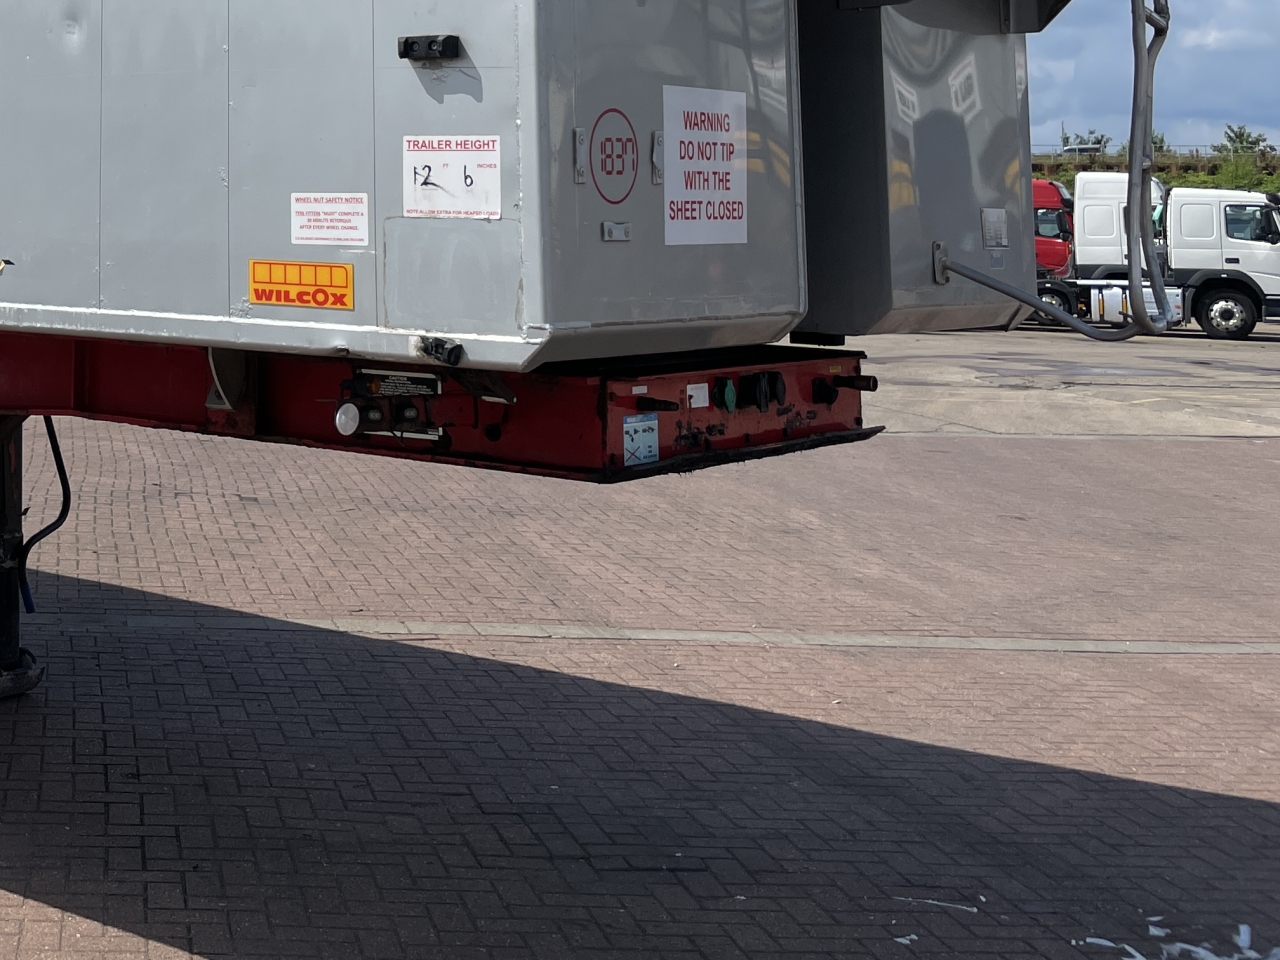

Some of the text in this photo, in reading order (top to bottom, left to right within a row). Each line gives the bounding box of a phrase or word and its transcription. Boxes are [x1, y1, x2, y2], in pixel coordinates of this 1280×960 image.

[683, 110, 730, 132] WARNING
[406, 140, 496, 149] TRAILER HEIGHT
[679, 140, 734, 161] DO NOT TIP
[464, 165, 473, 187] 6
[684, 171, 731, 190] WITH THE
[669, 201, 743, 220] SHEET CLOSED
[253, 288, 348, 306] WILCOX
